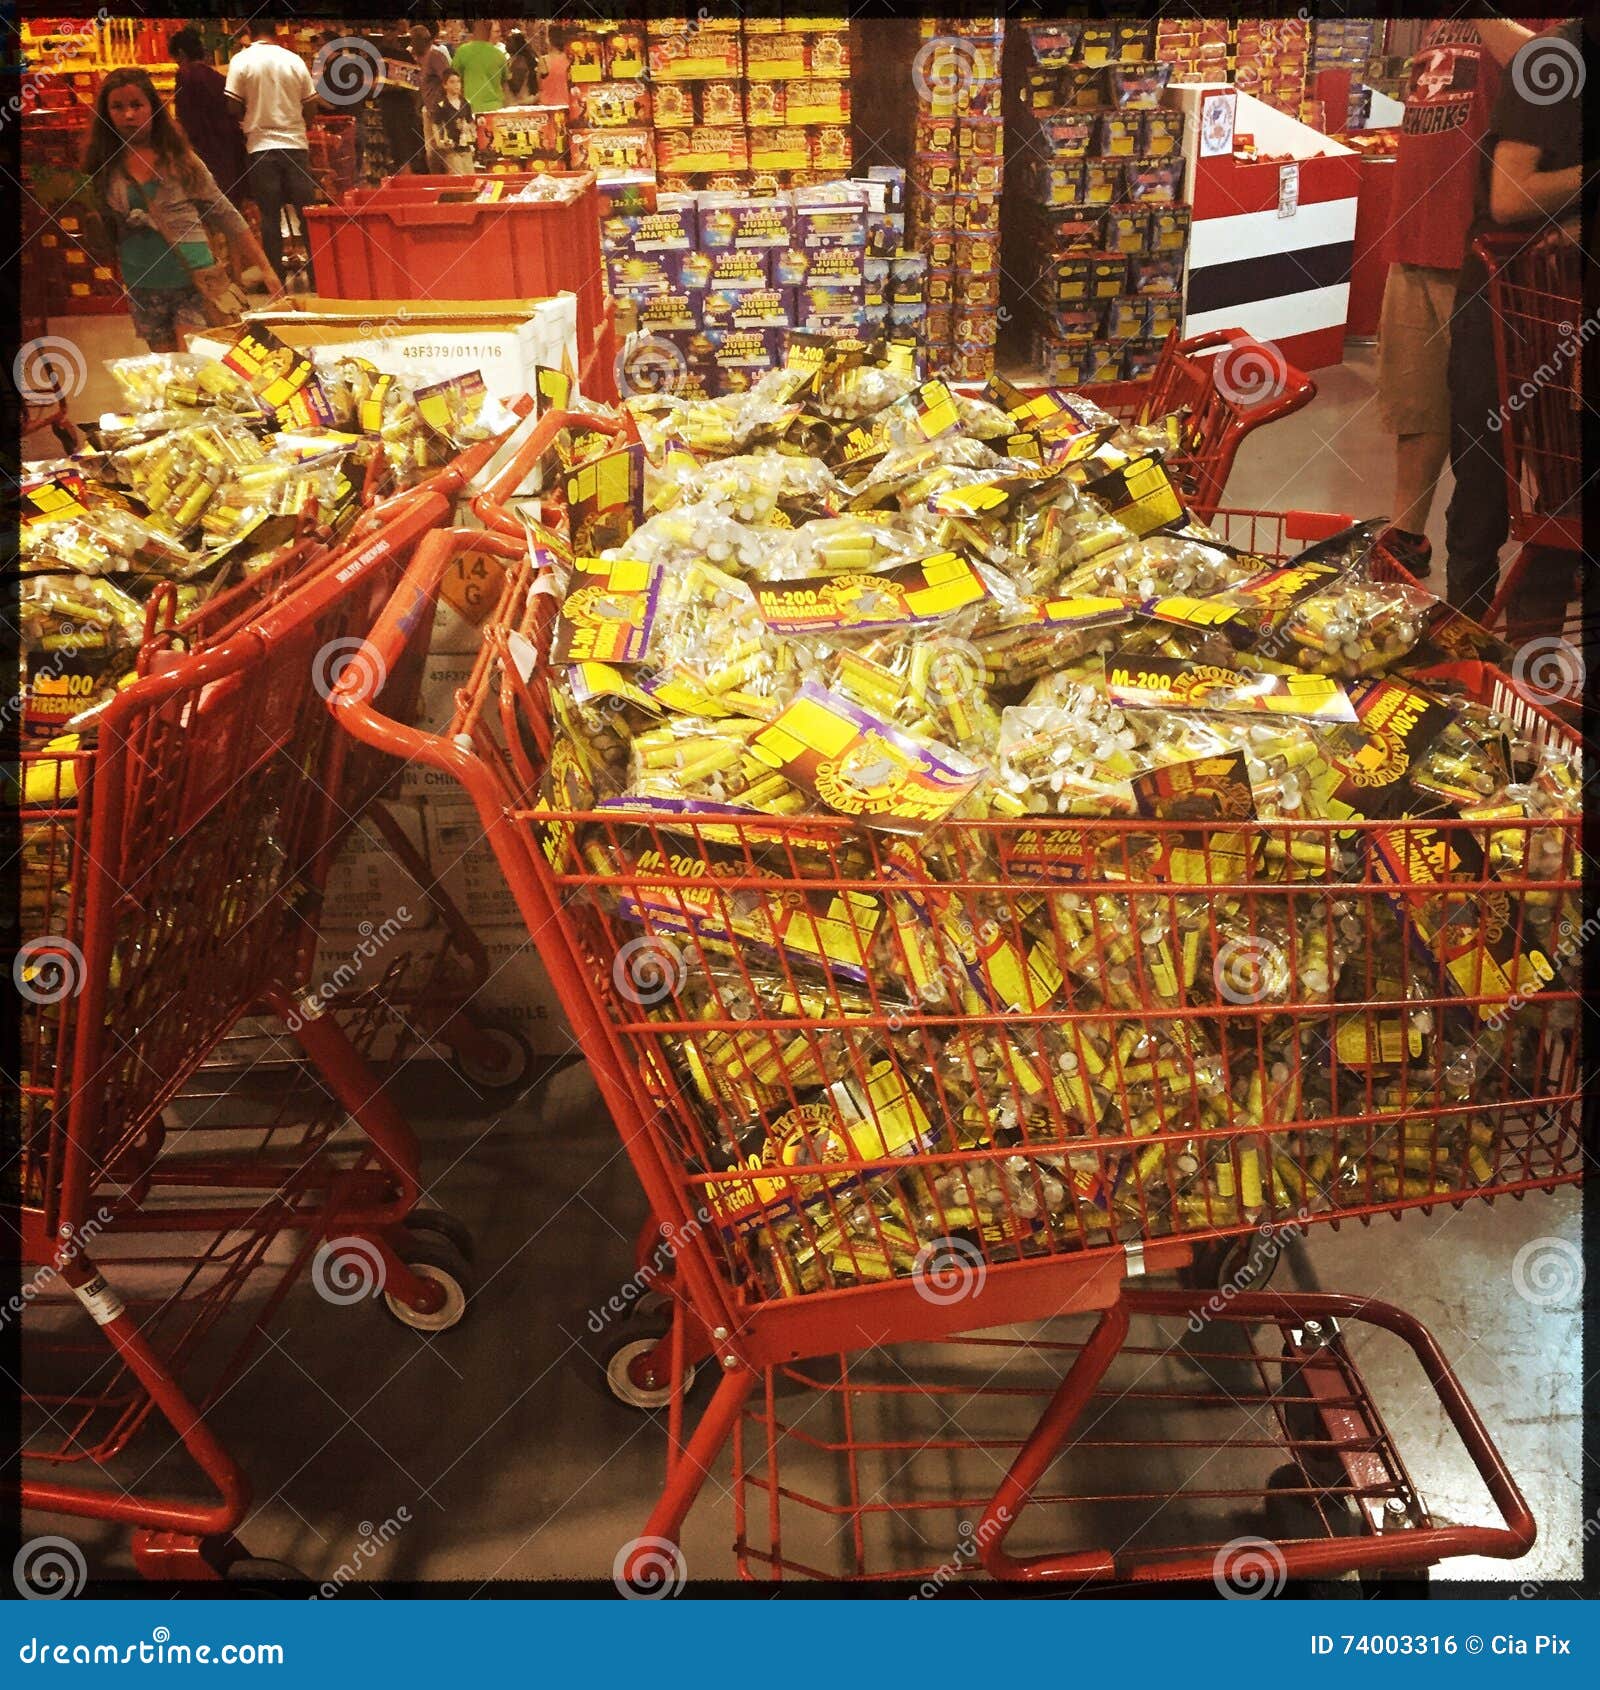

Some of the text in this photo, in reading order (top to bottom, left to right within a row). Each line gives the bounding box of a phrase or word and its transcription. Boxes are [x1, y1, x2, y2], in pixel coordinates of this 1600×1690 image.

[640, 223, 679, 231] JUMBO
[743, 220, 781, 228] JUMBO
[719, 262, 757, 270] JUMBO
[816, 259, 854, 267] JUMBO
[648, 304, 687, 312] JUMBO
[740, 300, 779, 308] JUMBO
[403, 346, 502, 358] 43F379/011/16
[723, 341, 761, 349] JUMBO
[789, 344, 825, 361] M-200
[451, 556, 488, 581] 1.4
[464, 584, 481, 606] G
[759, 590, 818, 607] M-200
[764, 603, 837, 619] FIRECRACKERS
[1110, 667, 1172, 690] M-200
[1387, 693, 1430, 737] M-200
[424, 772, 465, 786] CHIN
[1012, 843, 1083, 857] FIRERACKER
[636, 849, 706, 879] M-200
[713, 1175, 787, 1218] FRECRERS
